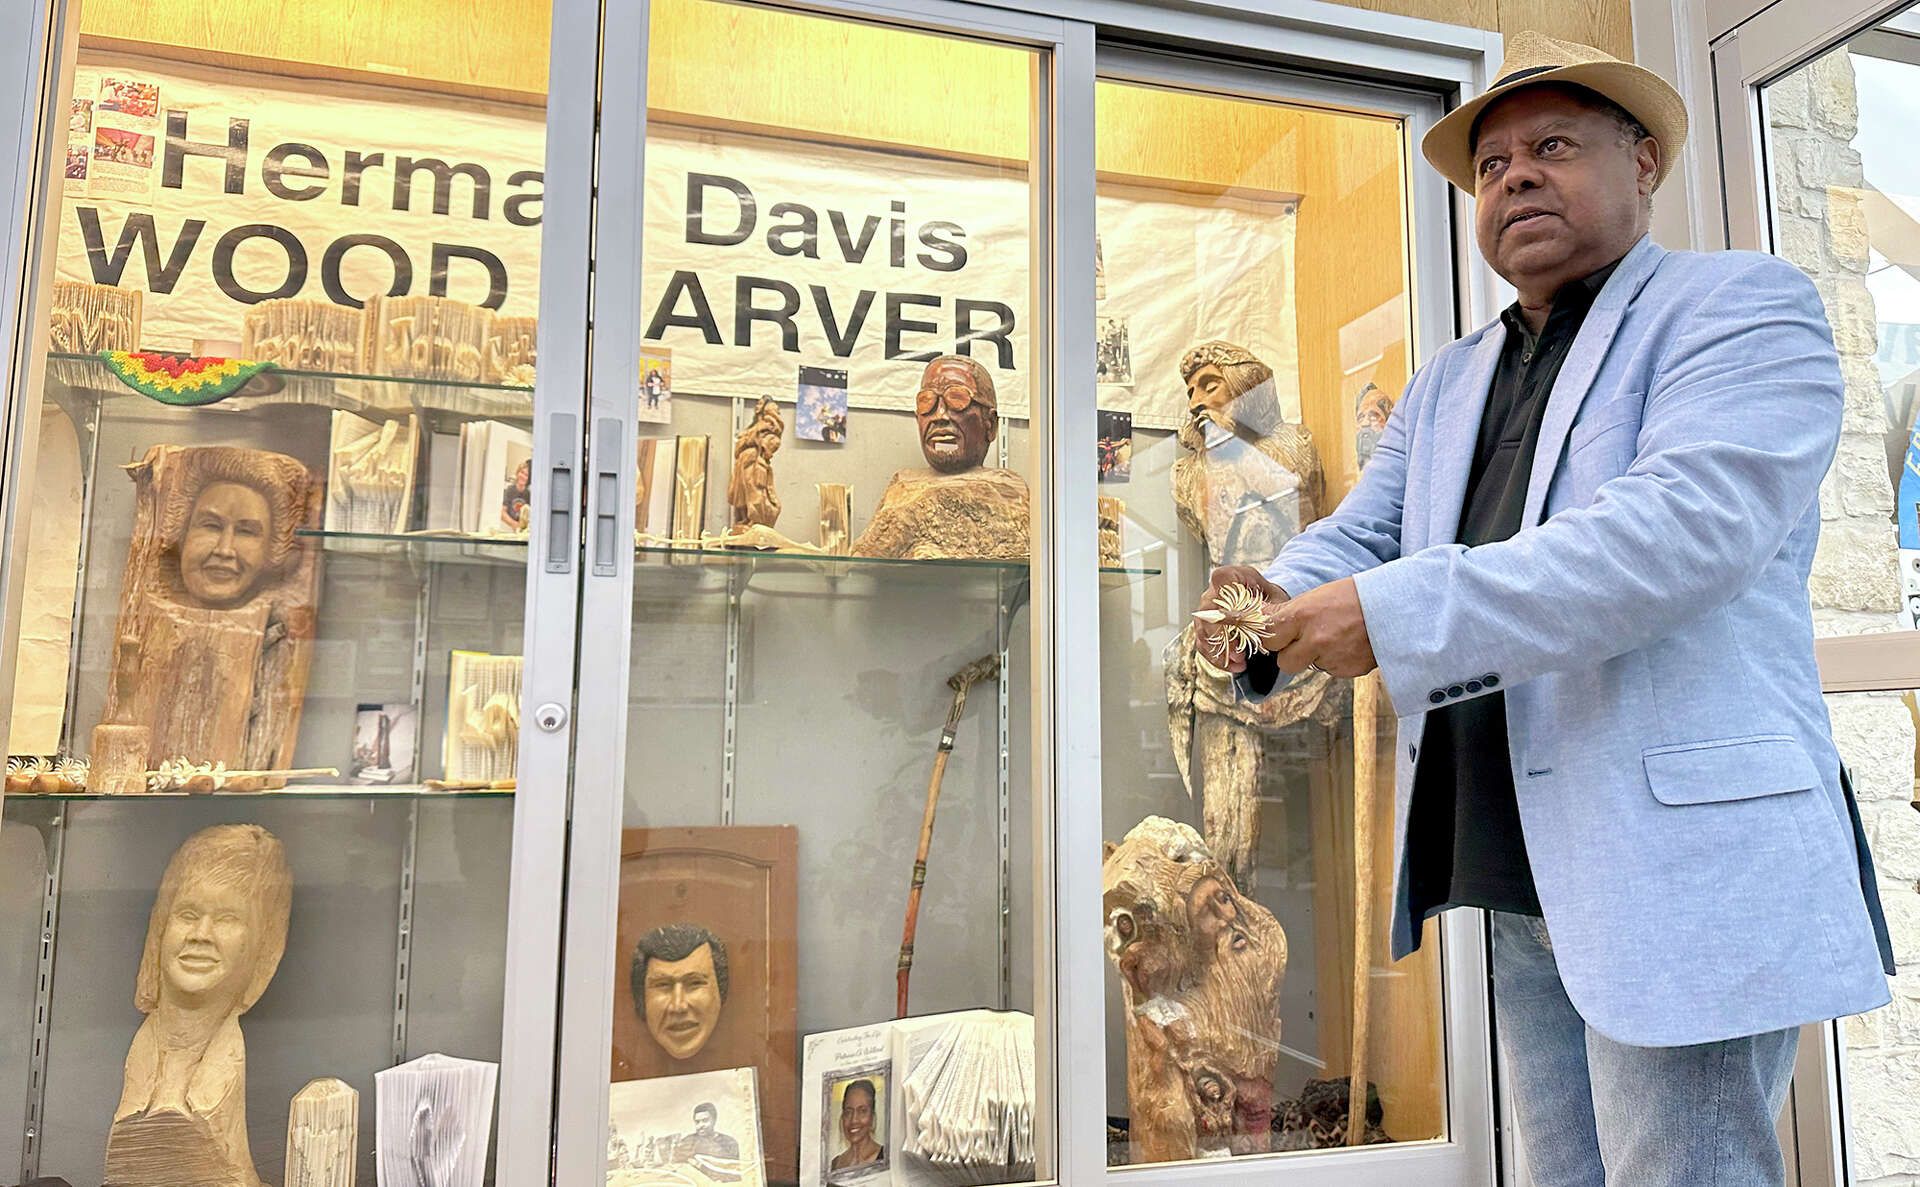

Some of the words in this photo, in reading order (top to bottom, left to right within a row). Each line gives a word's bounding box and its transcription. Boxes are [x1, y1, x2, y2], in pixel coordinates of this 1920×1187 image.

[161, 109, 545, 227] Herma
[685, 171, 968, 272] Davis
[75, 206, 508, 312] WOOD
[644, 270, 1016, 370] ARVER
